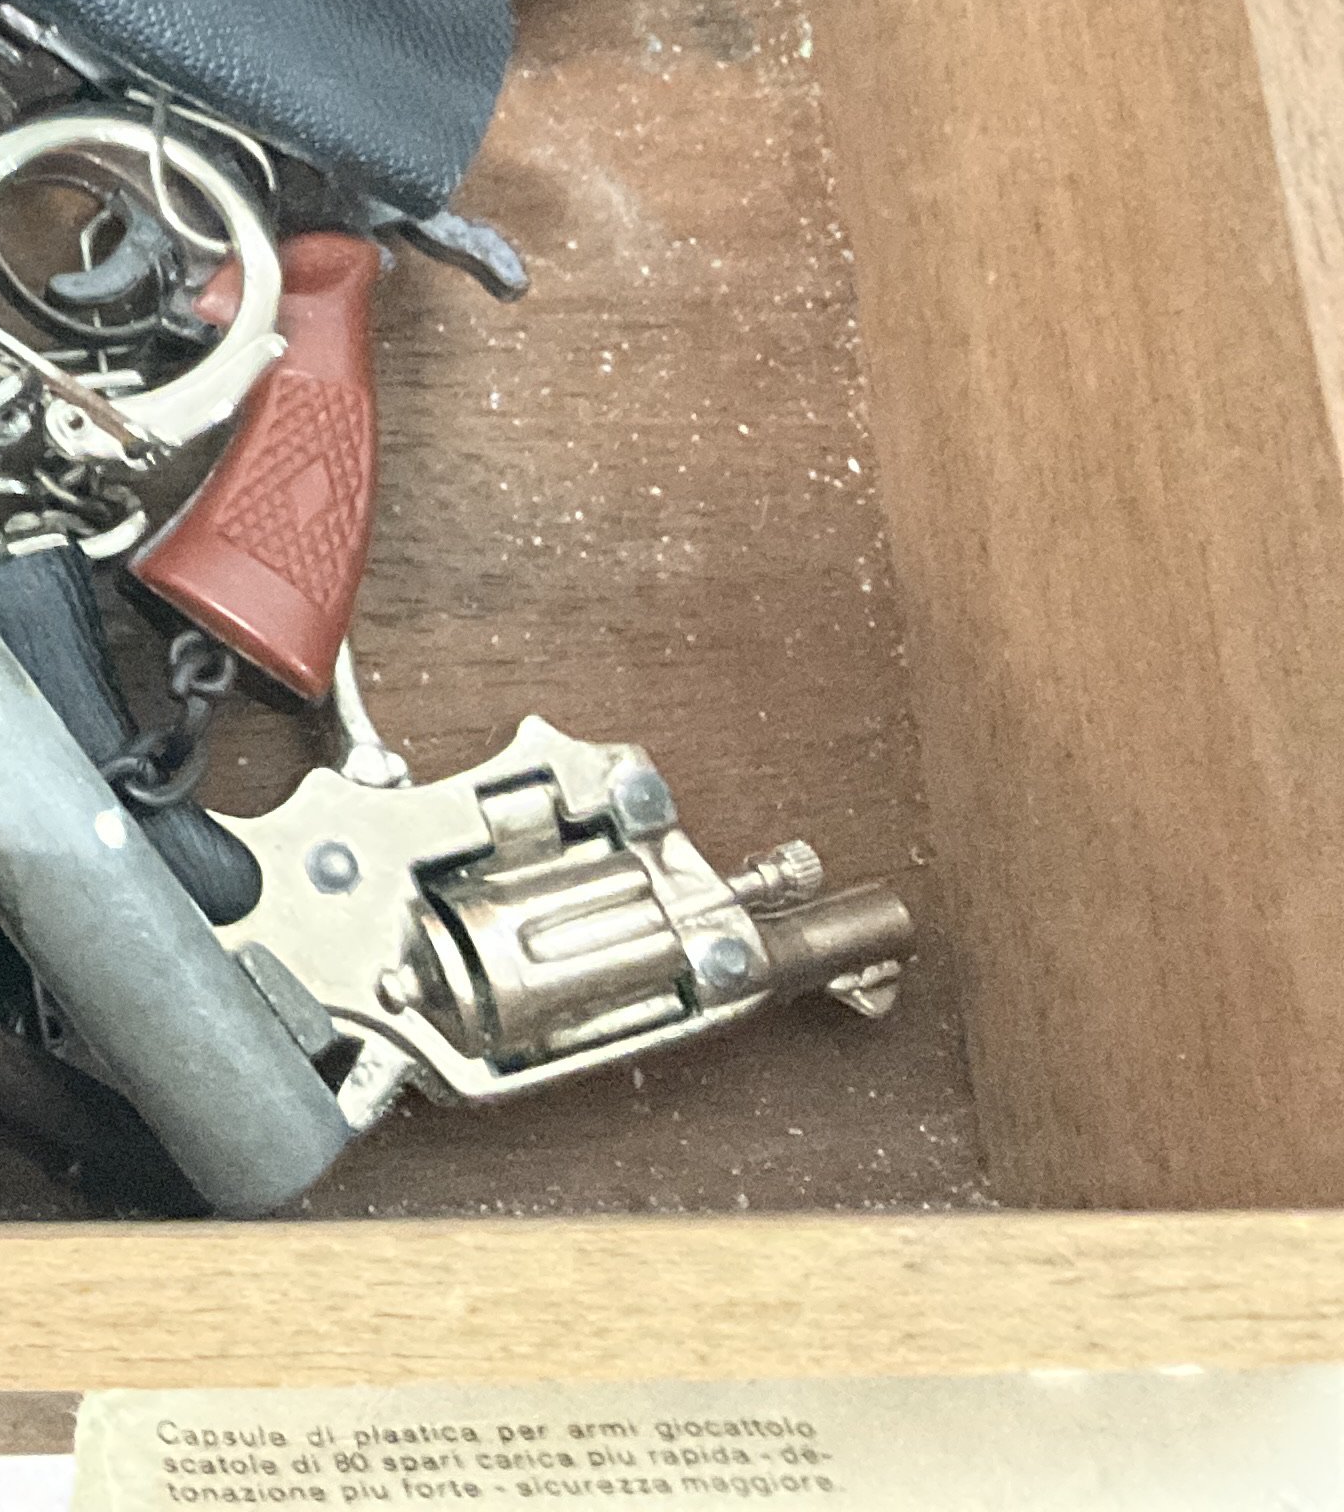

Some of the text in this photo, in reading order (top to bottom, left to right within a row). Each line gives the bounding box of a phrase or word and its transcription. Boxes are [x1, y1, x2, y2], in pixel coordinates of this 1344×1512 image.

[157, 1416, 817, 1449] Capsule di plastica per armi giocattolo
[162, 1452, 279, 1475] scatole
[291, 1453, 321, 1474] di
[333, 1451, 370, 1473] 80
[381, 1450, 464, 1473] spari
[475, 1448, 575, 1470] carica
[649, 1443, 751, 1467] rapida
[166, 1481, 328, 1503] tonazione
[402, 1477, 482, 1499] forte
[515, 1474, 674, 1498] sicurezza
